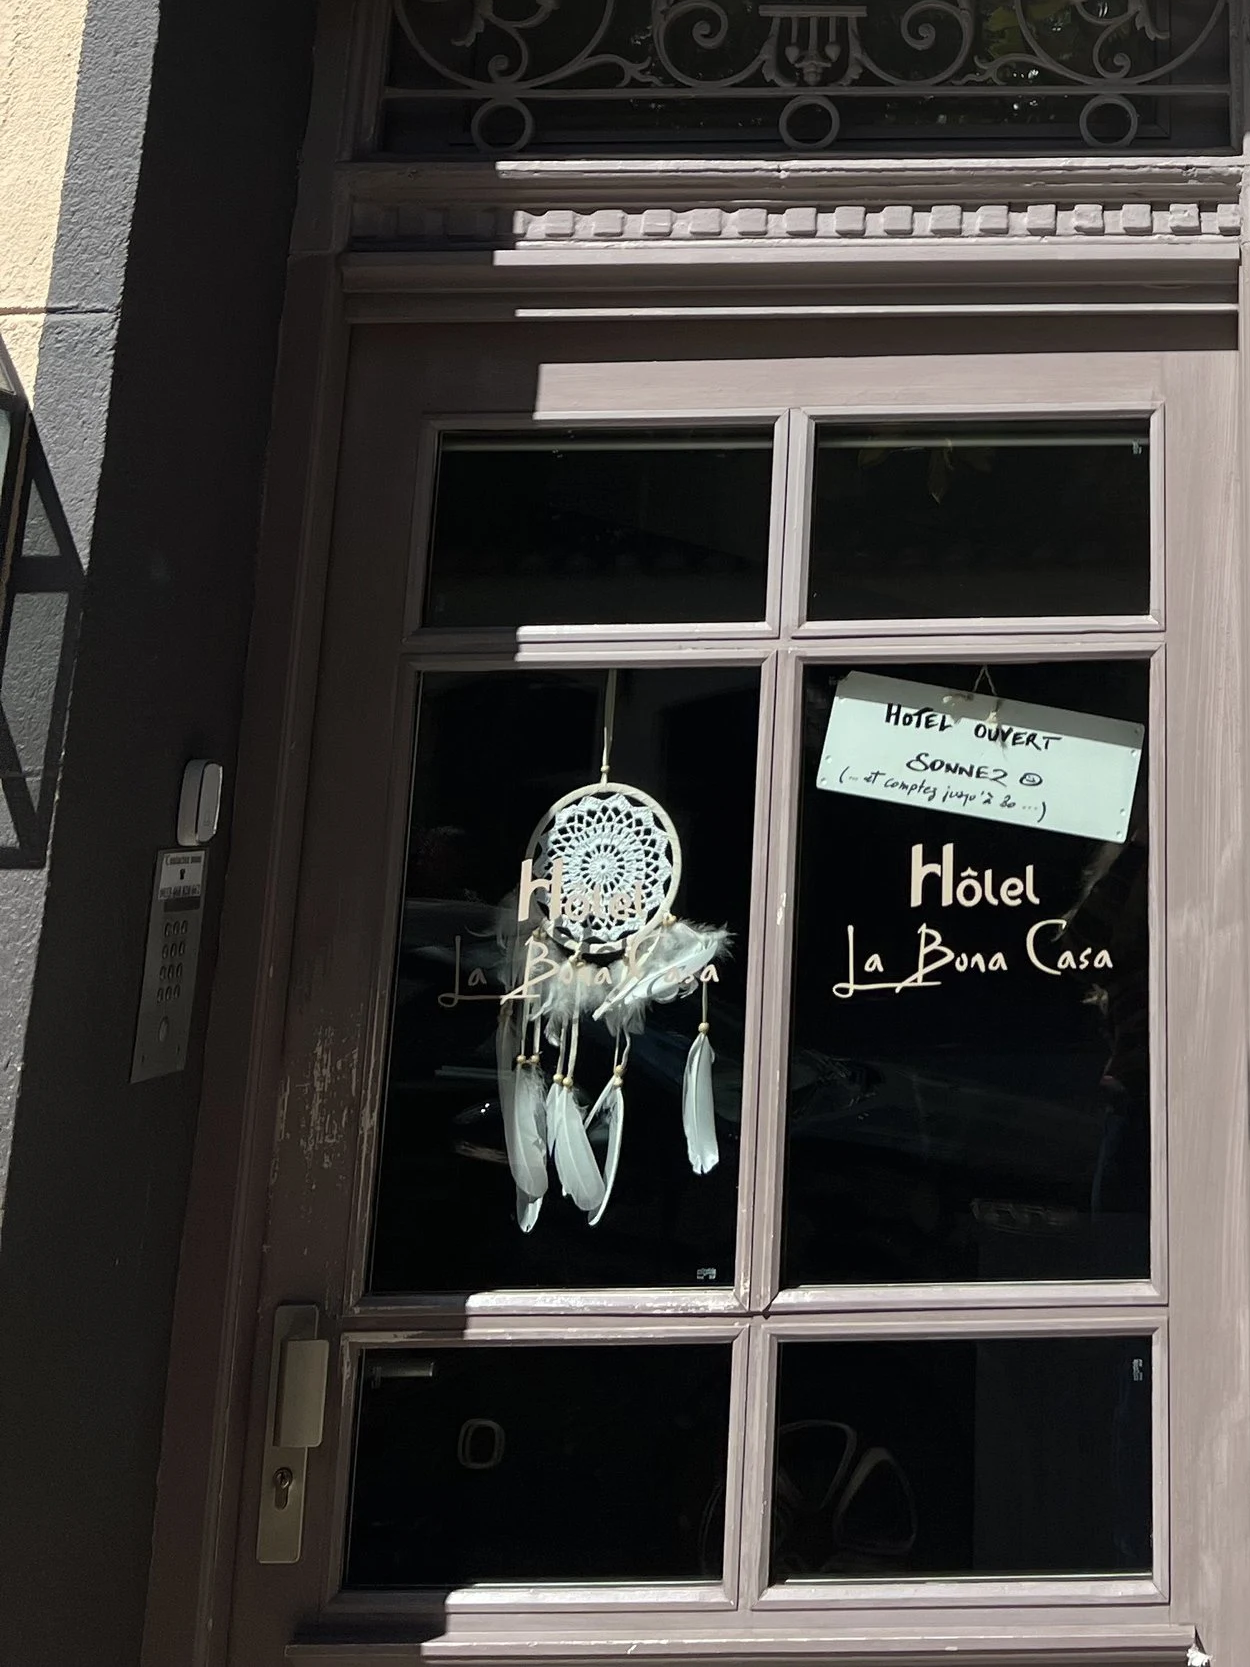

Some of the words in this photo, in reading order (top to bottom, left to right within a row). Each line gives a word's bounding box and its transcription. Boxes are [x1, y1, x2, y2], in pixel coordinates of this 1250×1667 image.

[885, 703, 954, 732] HOTEL
[974, 723, 1063, 752] OUVERT
[895, 922, 1008, 993] Bona
[1025, 918, 1114, 976] Casa
